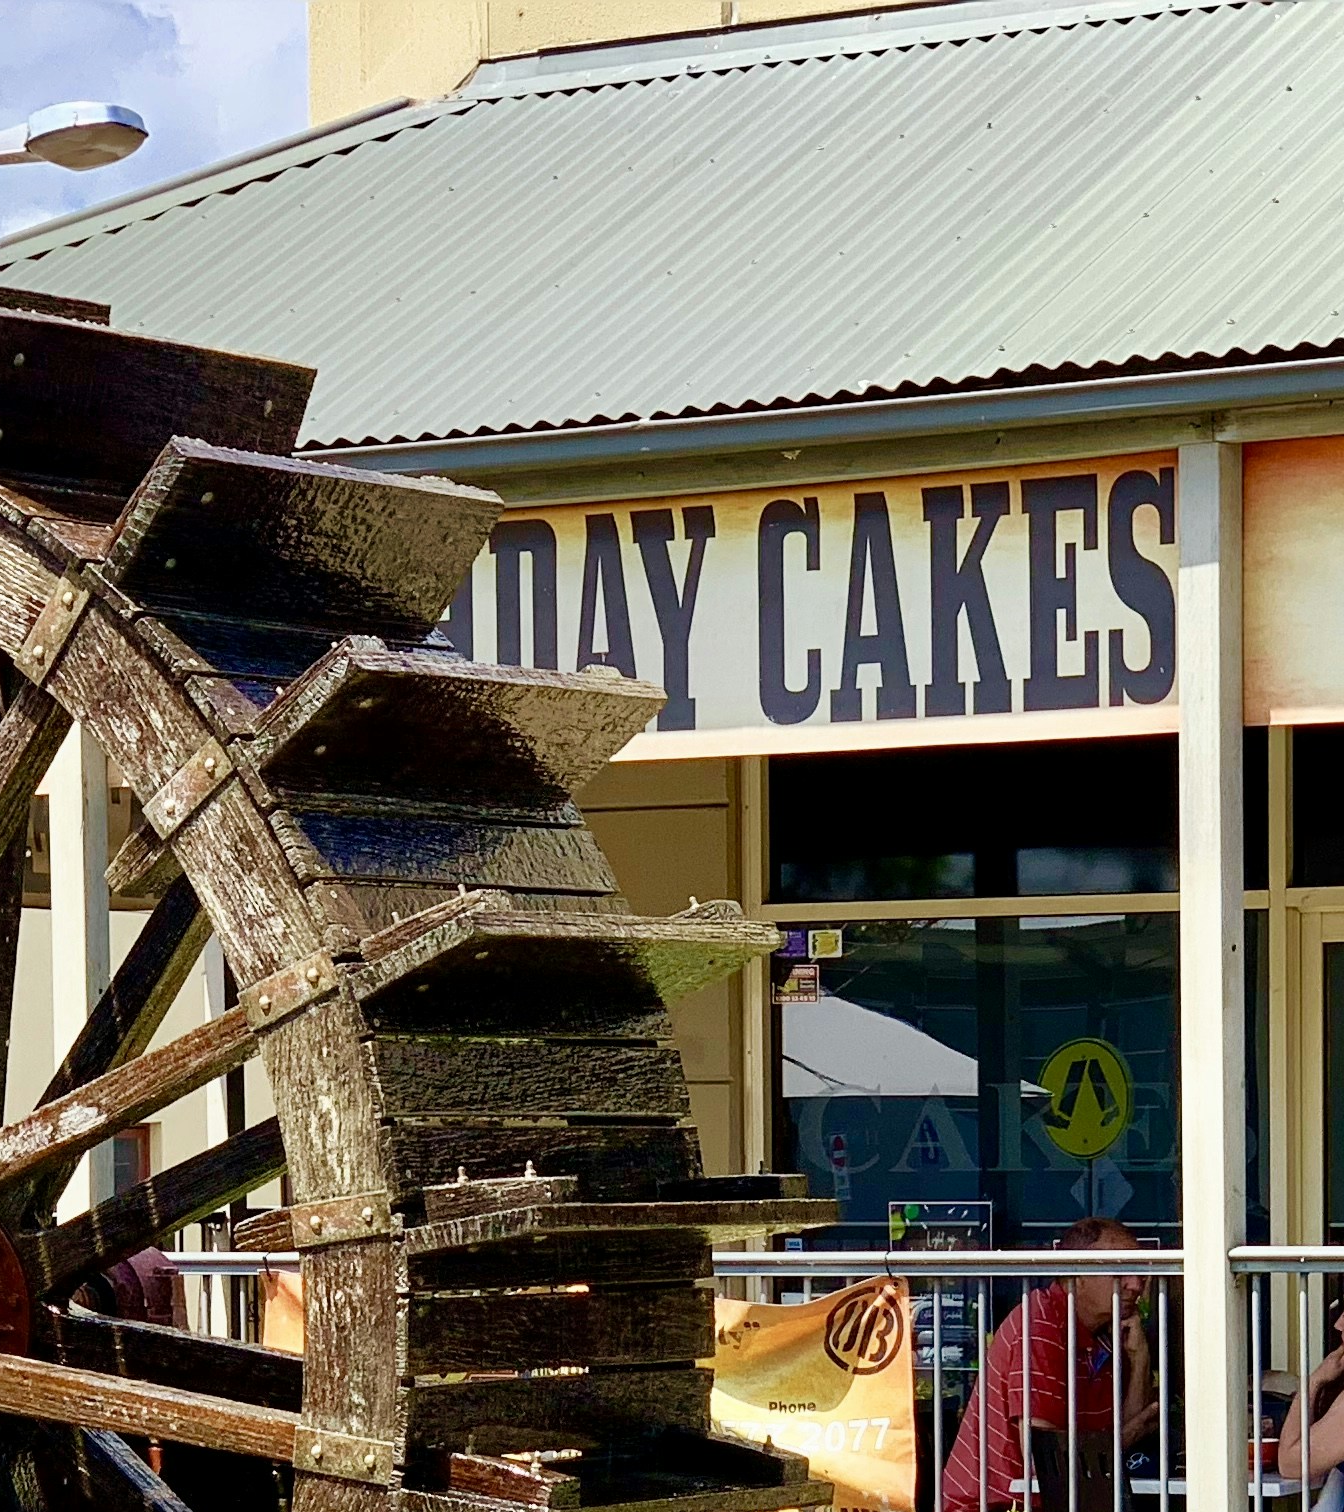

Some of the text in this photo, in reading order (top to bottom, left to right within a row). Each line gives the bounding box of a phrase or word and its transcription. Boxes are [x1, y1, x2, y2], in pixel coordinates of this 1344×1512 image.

[439, 505, 717, 731] DAY
[758, 466, 1175, 725] CAKES
[797, 1083, 1178, 1174] CAKE
[768, 1401, 817, 1414] Phone
